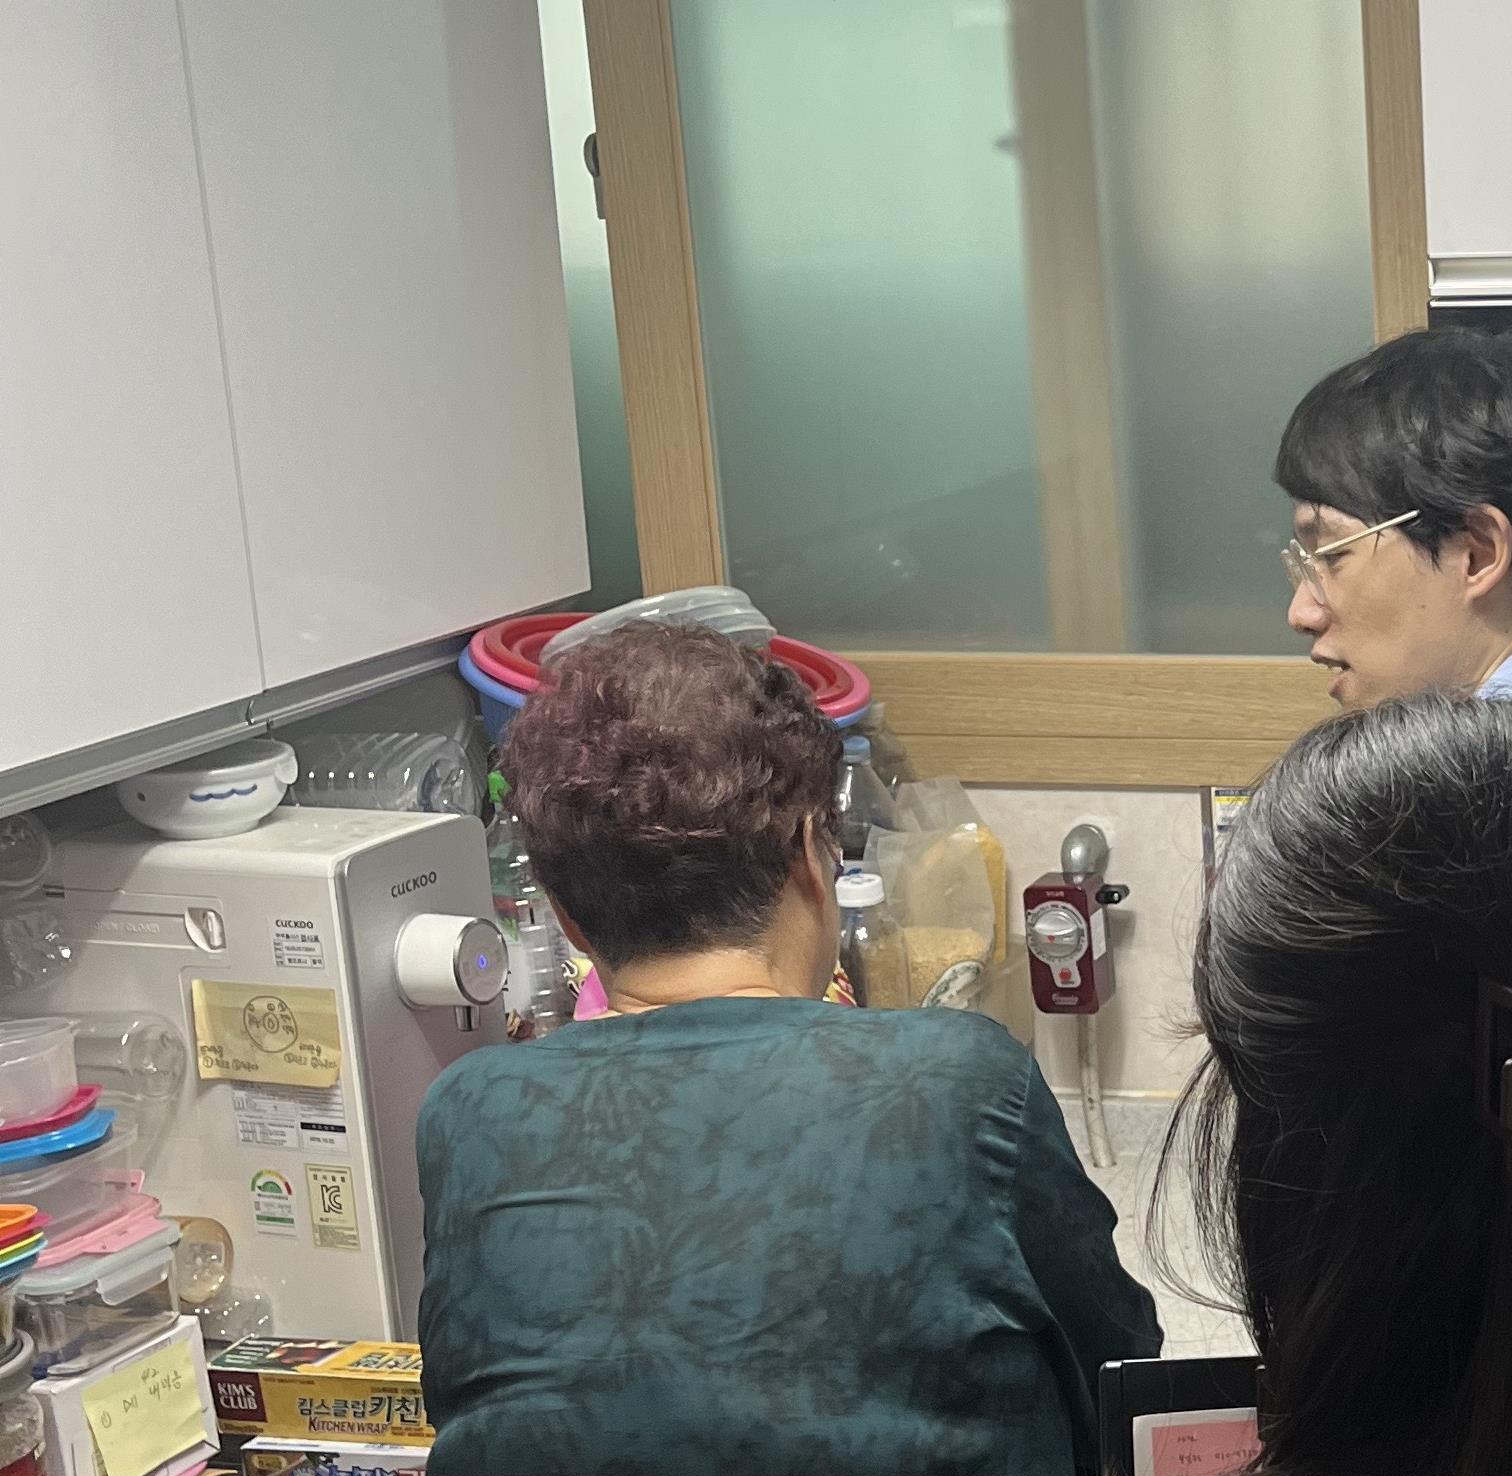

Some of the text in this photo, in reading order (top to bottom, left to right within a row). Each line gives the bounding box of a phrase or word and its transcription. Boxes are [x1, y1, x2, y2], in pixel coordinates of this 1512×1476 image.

[391, 871, 437, 898] CUCKOO
[275, 919, 314, 929] CUCKOO
[217, 1382, 255, 1397] KIM'S
[220, 1396, 258, 1410] CLUB
[308, 1417, 354, 1434] KITCHEN
[355, 1422, 389, 1436] WRAP
